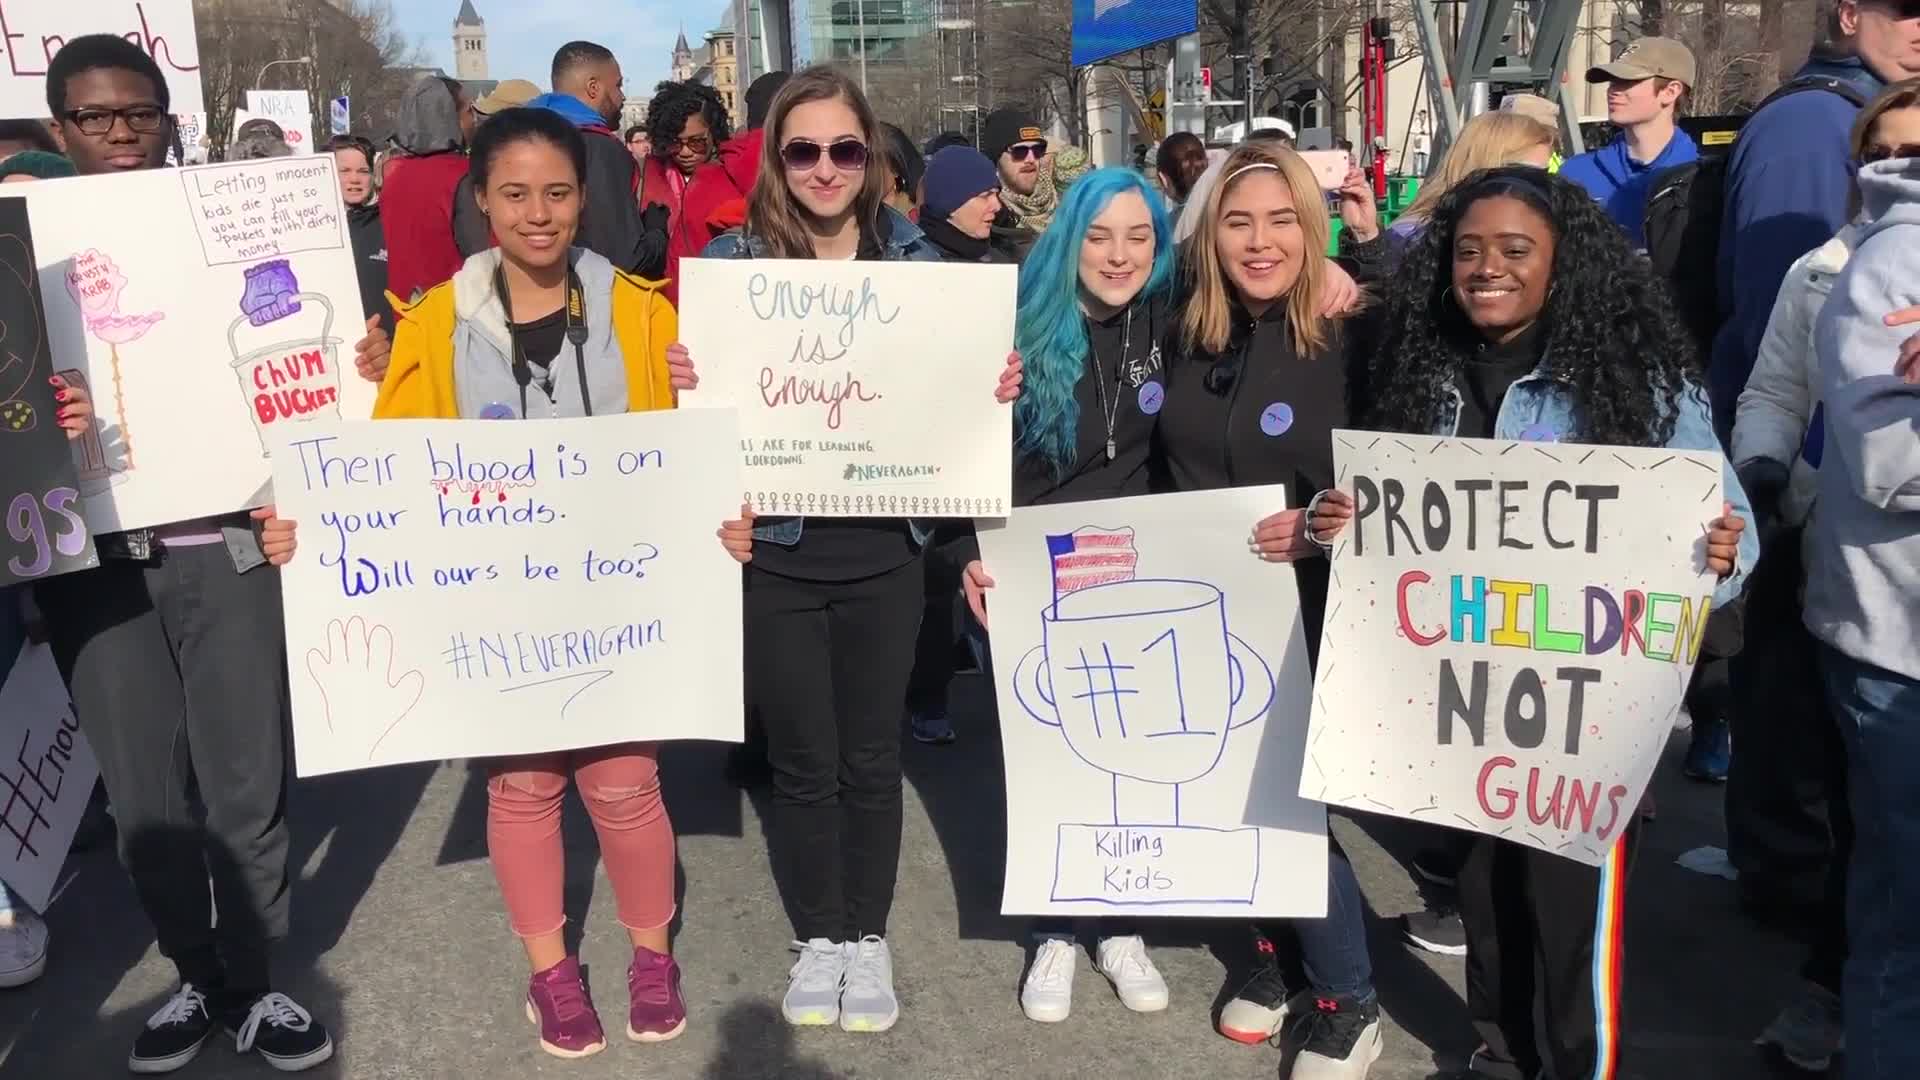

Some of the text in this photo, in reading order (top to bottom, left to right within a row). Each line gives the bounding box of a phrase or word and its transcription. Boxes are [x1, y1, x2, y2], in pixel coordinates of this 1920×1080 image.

[260, 96, 296, 115] NRA
[195, 164, 328, 198] Letting innocent
[201, 187, 318, 220] kids die just so
[211, 204, 323, 241] you can fill your
[222, 213, 337, 248] pockets with dirty
[238, 240, 280, 258] money
[81, 278, 111, 297] KRAB
[789, 329, 847, 365] is
[253, 386, 337, 425] BUCKET
[289, 436, 662, 490] Their blood is on
[762, 439, 785, 451] ARE
[792, 440, 812, 450] FOR
[319, 493, 567, 567] your hands.
[1352, 475, 1620, 556] PROTECT
[341, 542, 659, 597] Will ours be too?
[1397, 570, 1712, 665] CHILDREN
[1065, 628, 1217, 738] #1
[1437, 659, 1602, 755] NOT
[1476, 756, 1628, 841] GUNS
[1095, 829, 1163, 858] Killing
[1103, 864, 1173, 892] Kids
